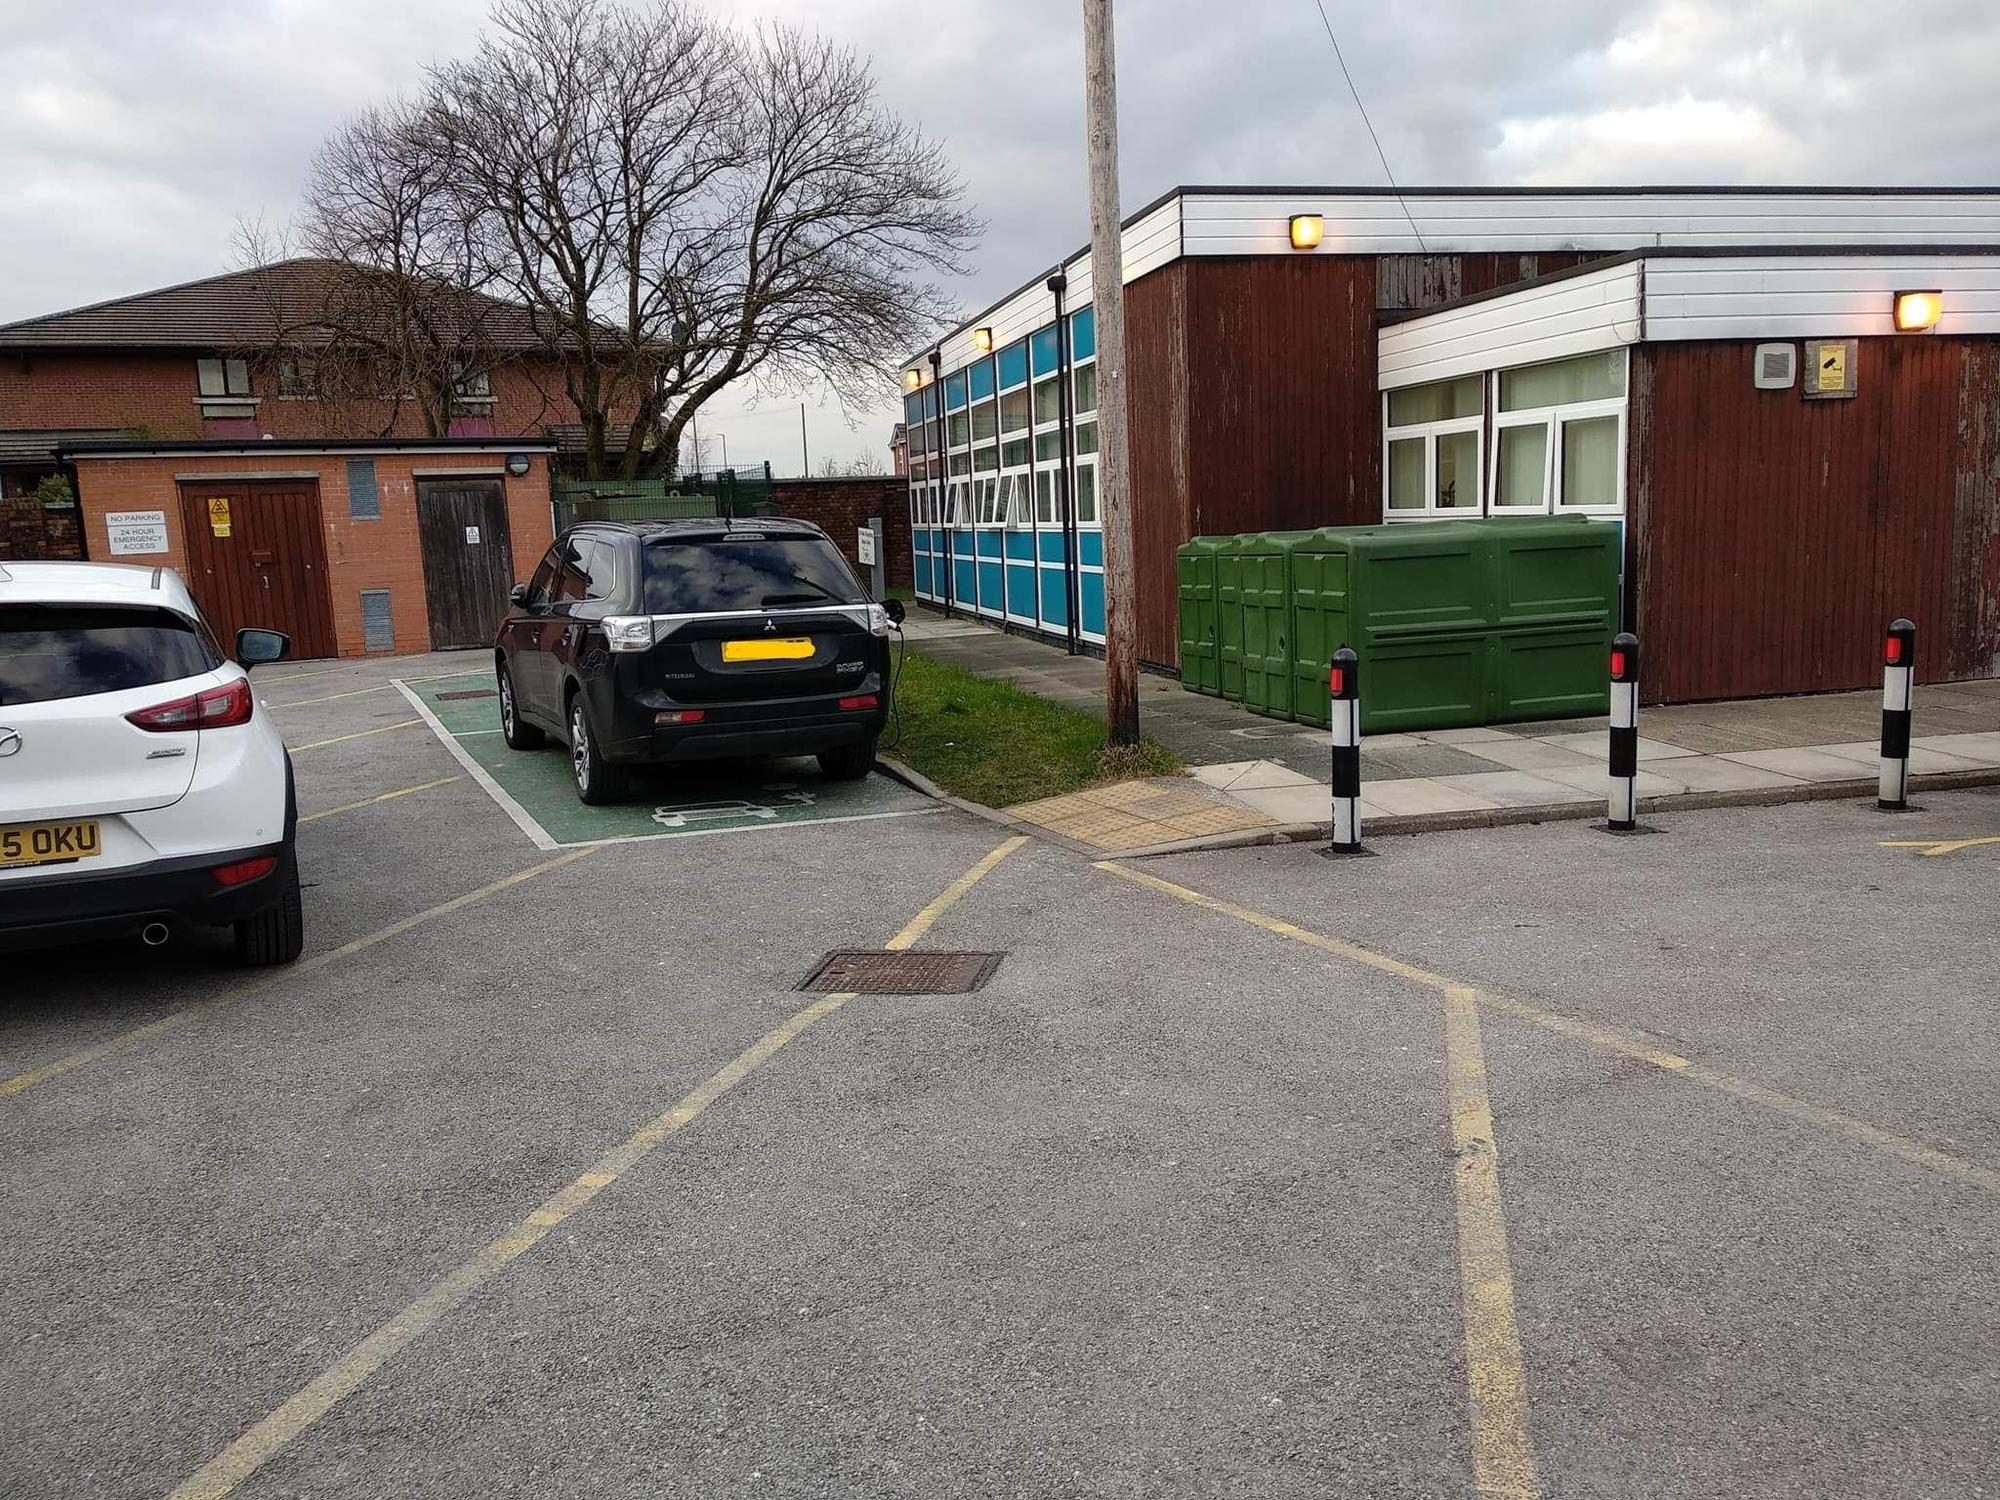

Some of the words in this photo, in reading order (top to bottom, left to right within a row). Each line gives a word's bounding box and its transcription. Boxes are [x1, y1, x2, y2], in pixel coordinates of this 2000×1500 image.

[110, 514, 123, 522] NO
[125, 514, 161, 522] PARKING
[132, 528, 155, 536] HOUR
[113, 535, 164, 543] EMERGENCY
[123, 542, 156, 550] ACCESS
[2, 831, 22, 857] 5
[32, 825, 96, 854] OKU
